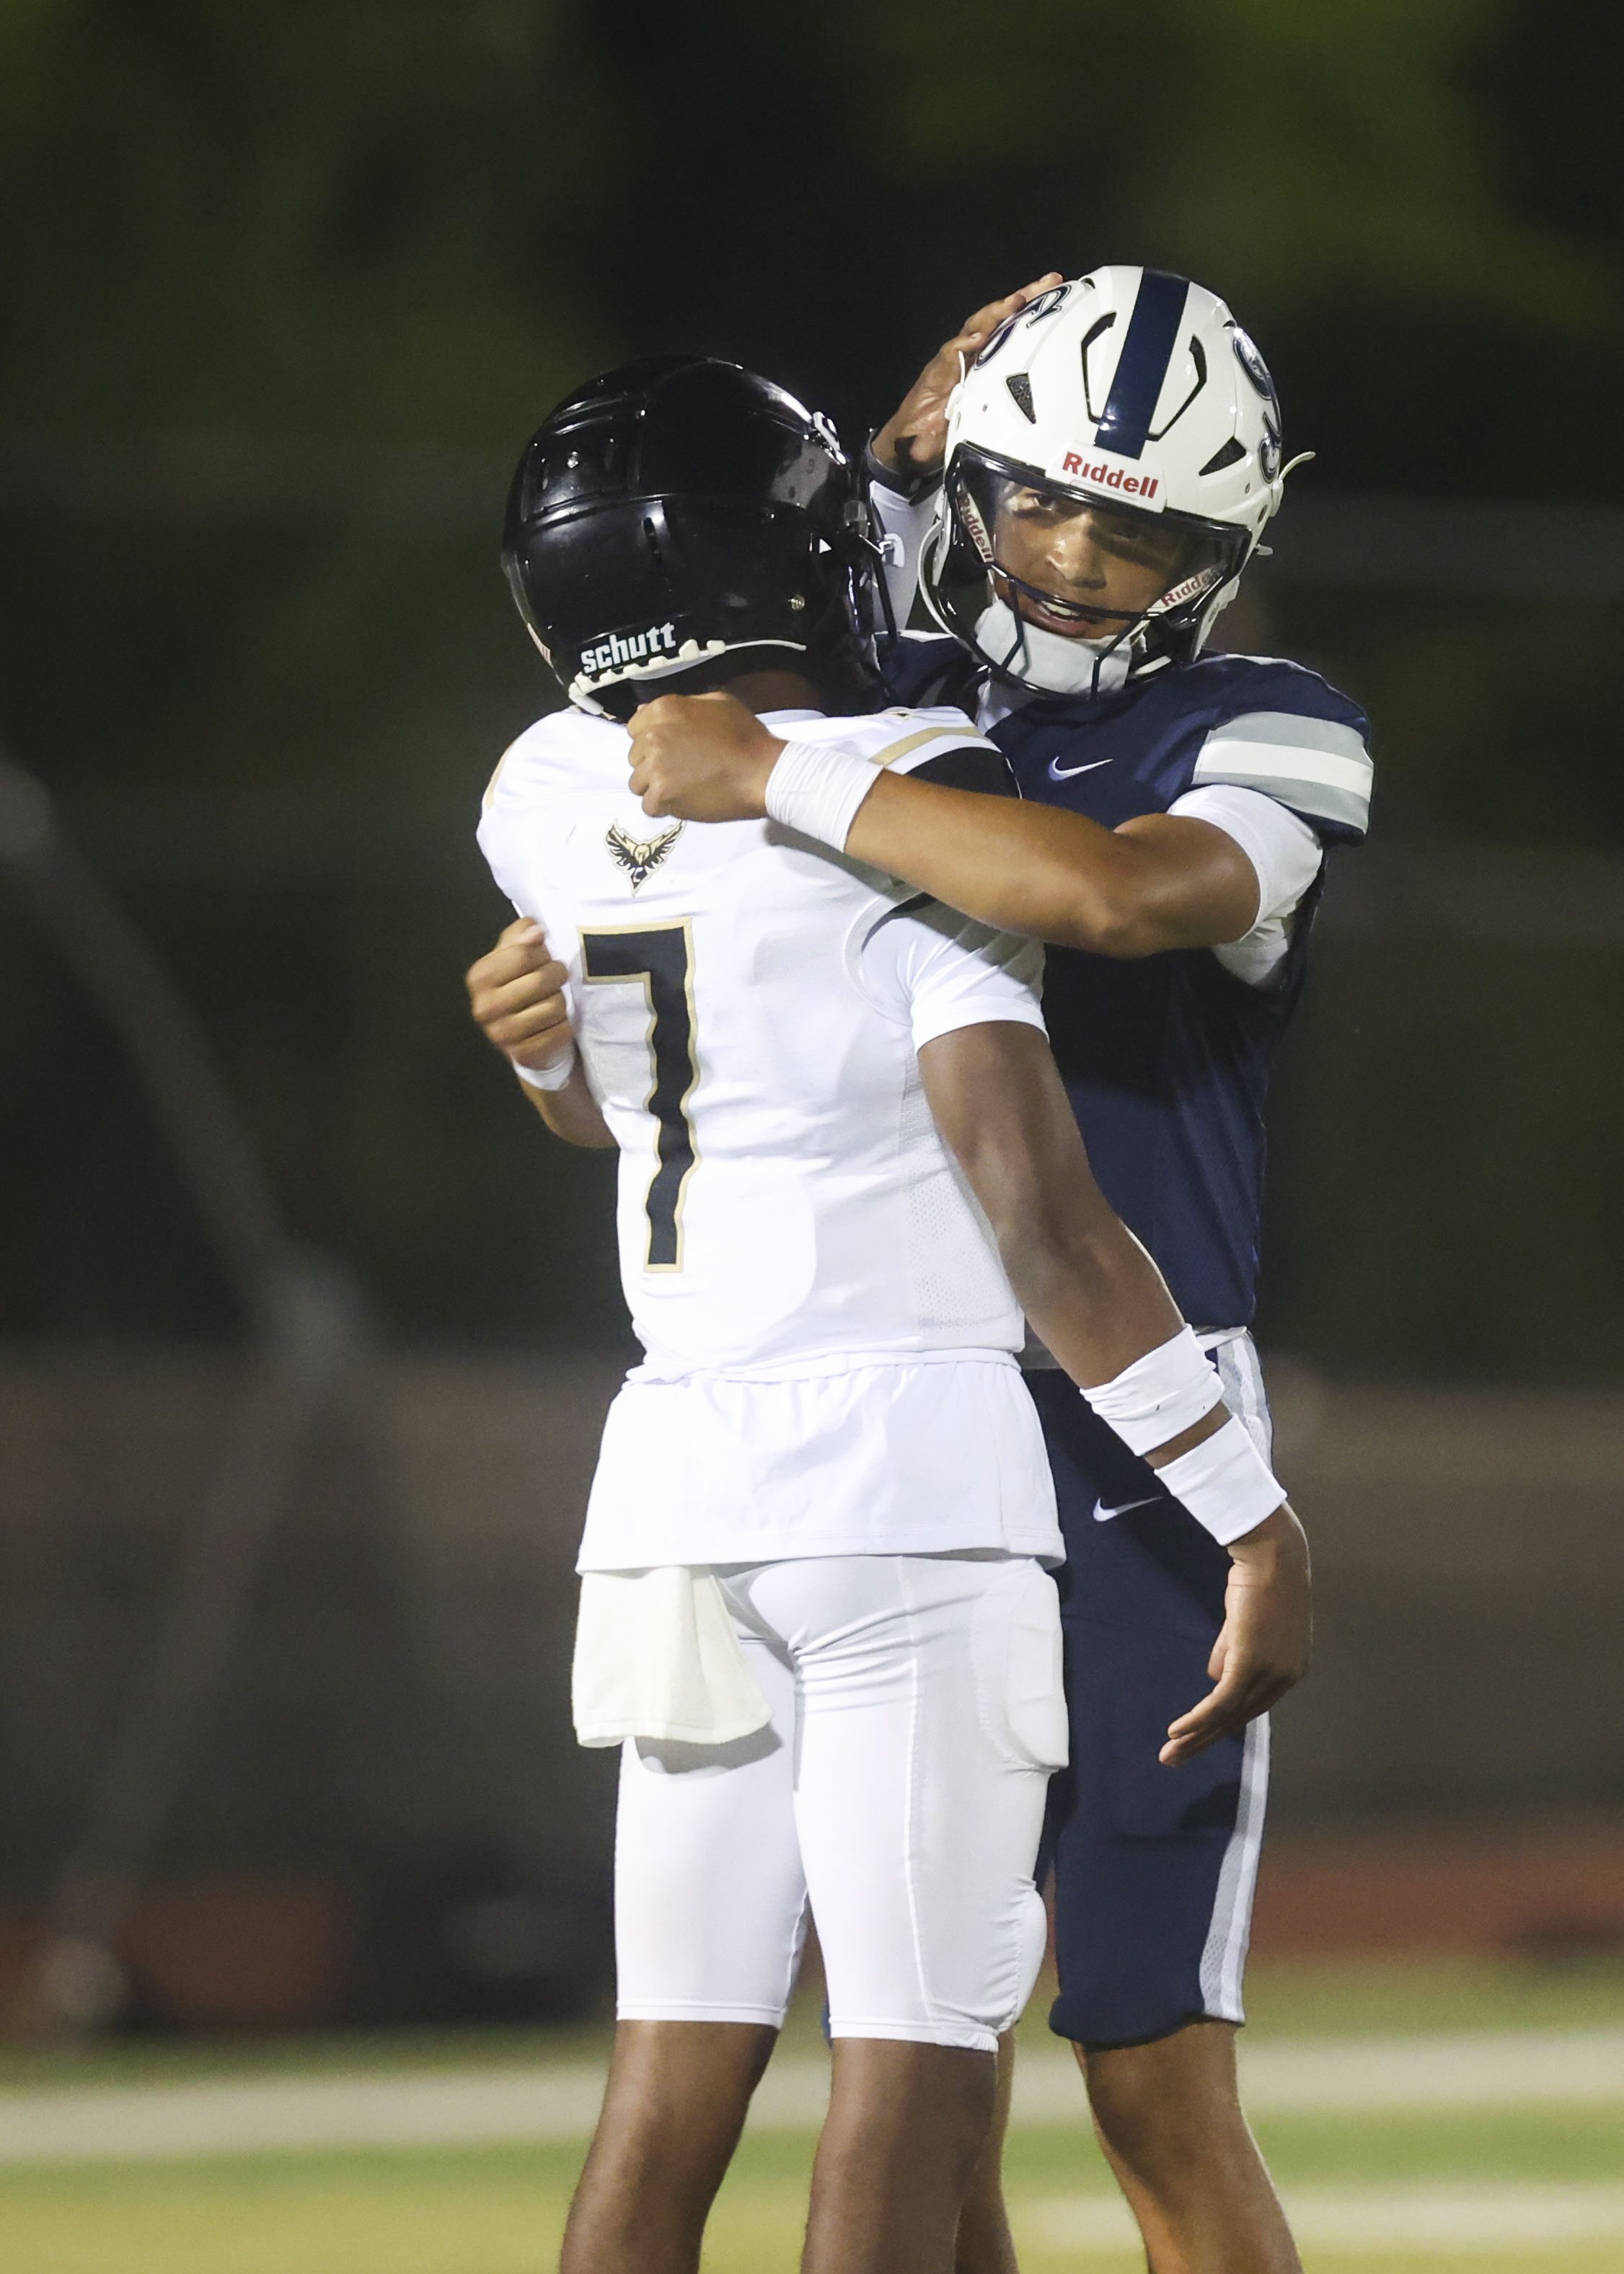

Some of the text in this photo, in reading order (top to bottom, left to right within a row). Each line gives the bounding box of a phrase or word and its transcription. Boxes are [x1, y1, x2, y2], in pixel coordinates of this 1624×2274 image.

[1062, 451, 1159, 499] Riddell
[581, 622, 676, 674] schutt
[578, 917, 702, 1273] 7
